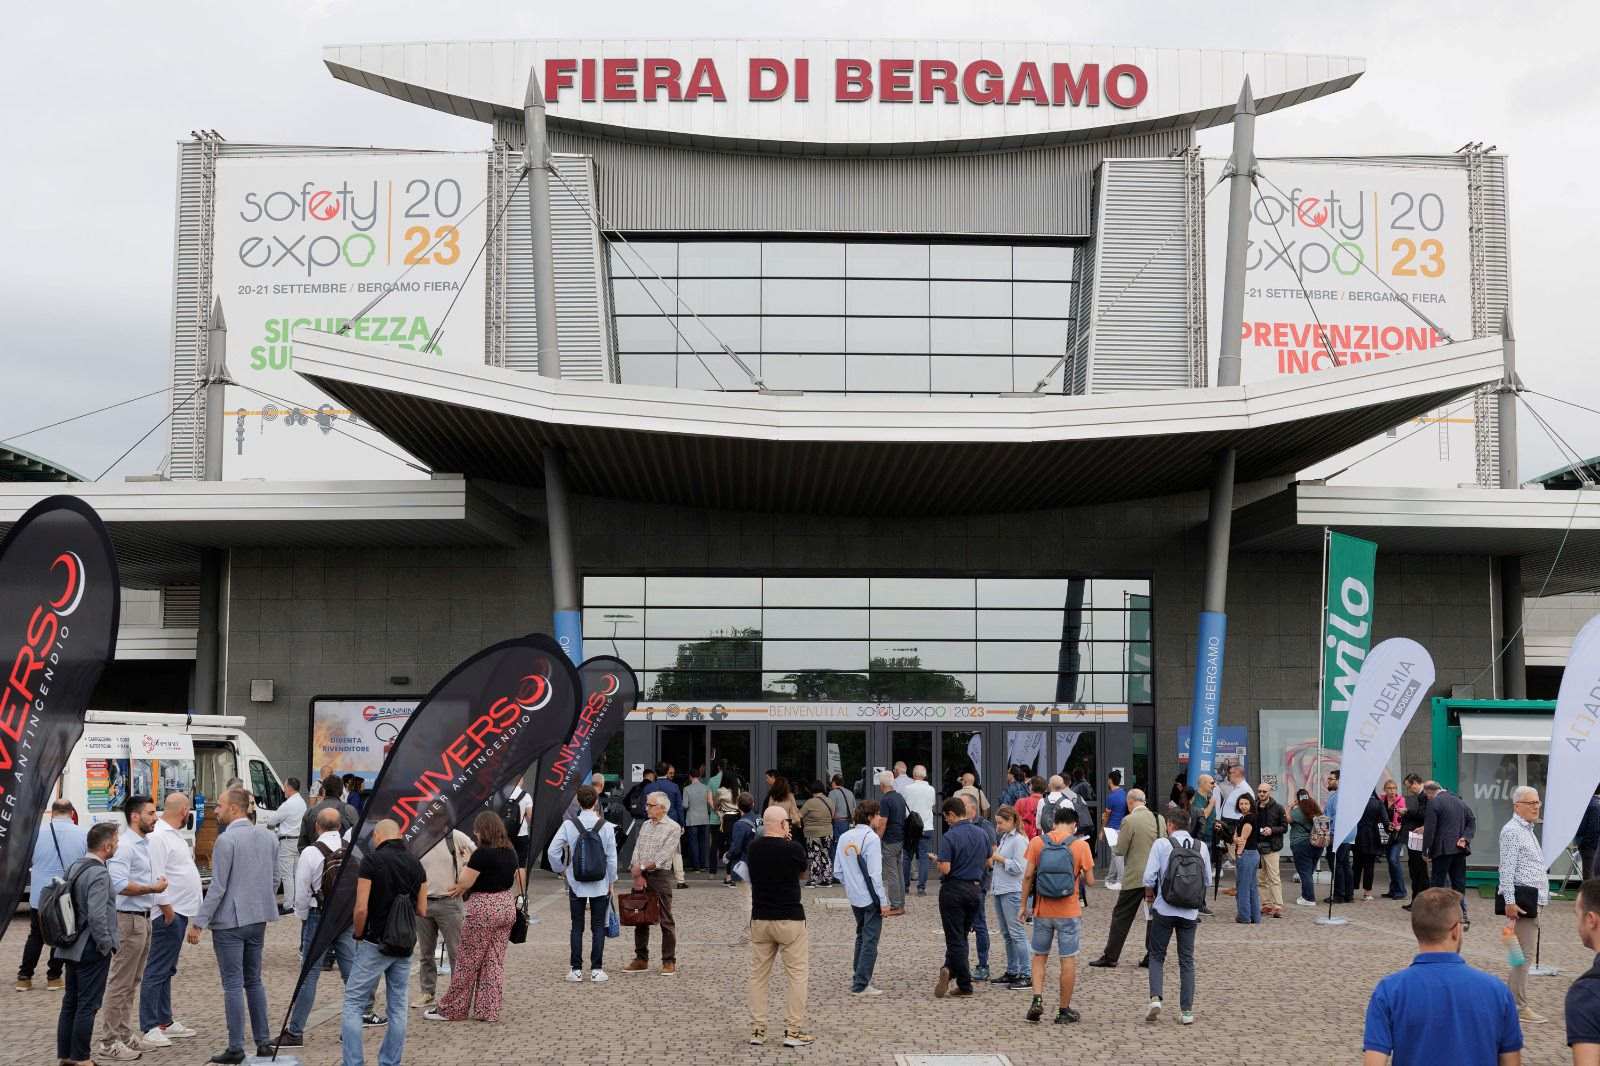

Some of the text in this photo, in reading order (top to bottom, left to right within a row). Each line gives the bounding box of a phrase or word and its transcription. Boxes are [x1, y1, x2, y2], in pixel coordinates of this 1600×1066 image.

[544, 57, 1149, 109] FIERA DI BERGAMO
[239, 178, 462, 232] safety 20
[1248, 187, 1444, 241] afety 20
[239, 224, 462, 278] expo 23
[1391, 237, 1446, 278] 23
[237, 284, 269, 296] 20-21
[272, 282, 347, 295] SETTEMBRE
[357, 281, 420, 293] BERGAMO
[423, 280, 460, 292] FIERA
[1265, 288, 1338, 300] SETTEMBRE
[1349, 290, 1409, 303] BERGAMO
[1412, 293, 1447, 304] FIERA
[1326, 576, 1370, 712] wilo
[15, 625, 69, 784] ANTINCENDIO
[954, 706, 985, 718] 2023
[1201, 636, 1220, 754] FIERA di BERGAMO
[404, 715, 531, 842] ARTNER ANTINCENDIO
